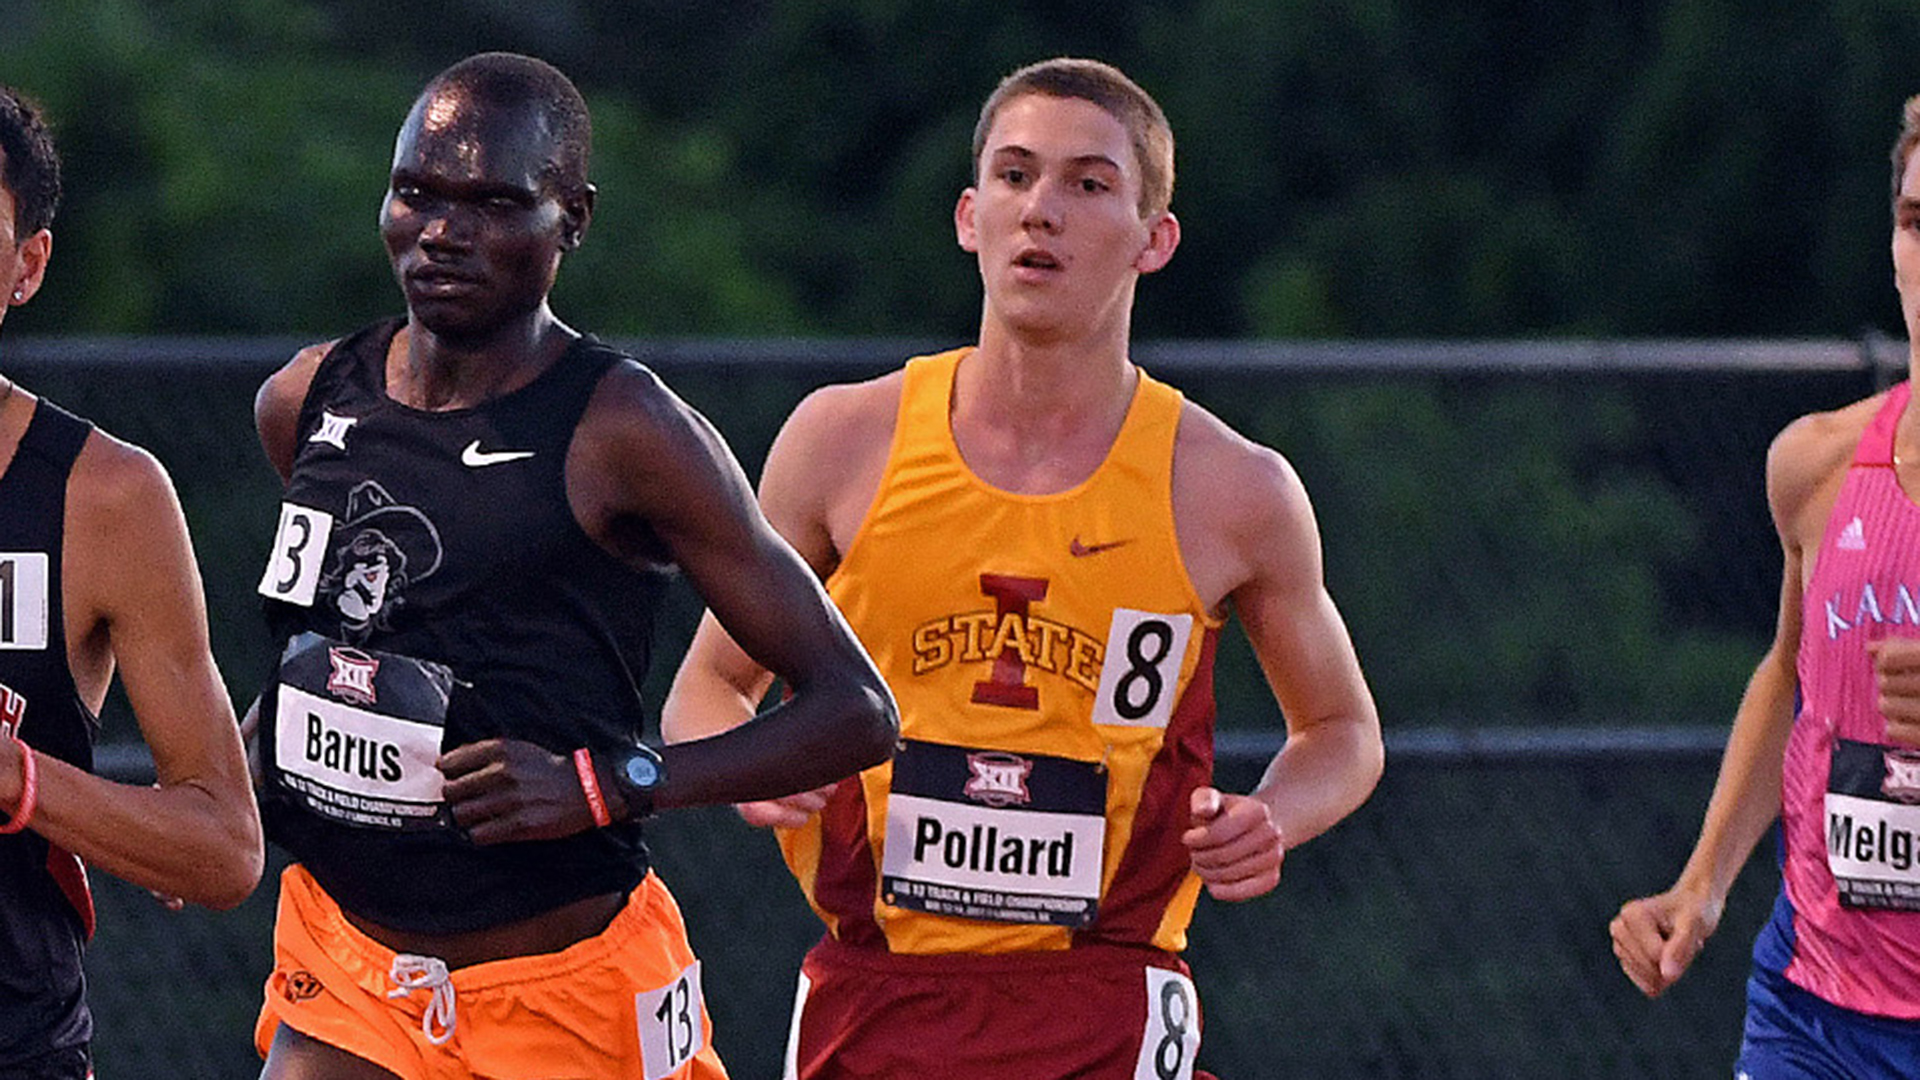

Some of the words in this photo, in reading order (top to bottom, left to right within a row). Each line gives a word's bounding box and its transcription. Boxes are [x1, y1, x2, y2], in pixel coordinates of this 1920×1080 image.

[912, 610, 1108, 698] STATE
[1113, 620, 1175, 720] 8
[305, 711, 402, 782] Barus
[913, 815, 1074, 878] Pollard
[1829, 813, 1920, 871] Melg
[655, 976, 692, 1068] 13
[1155, 981, 1189, 1080] 8
